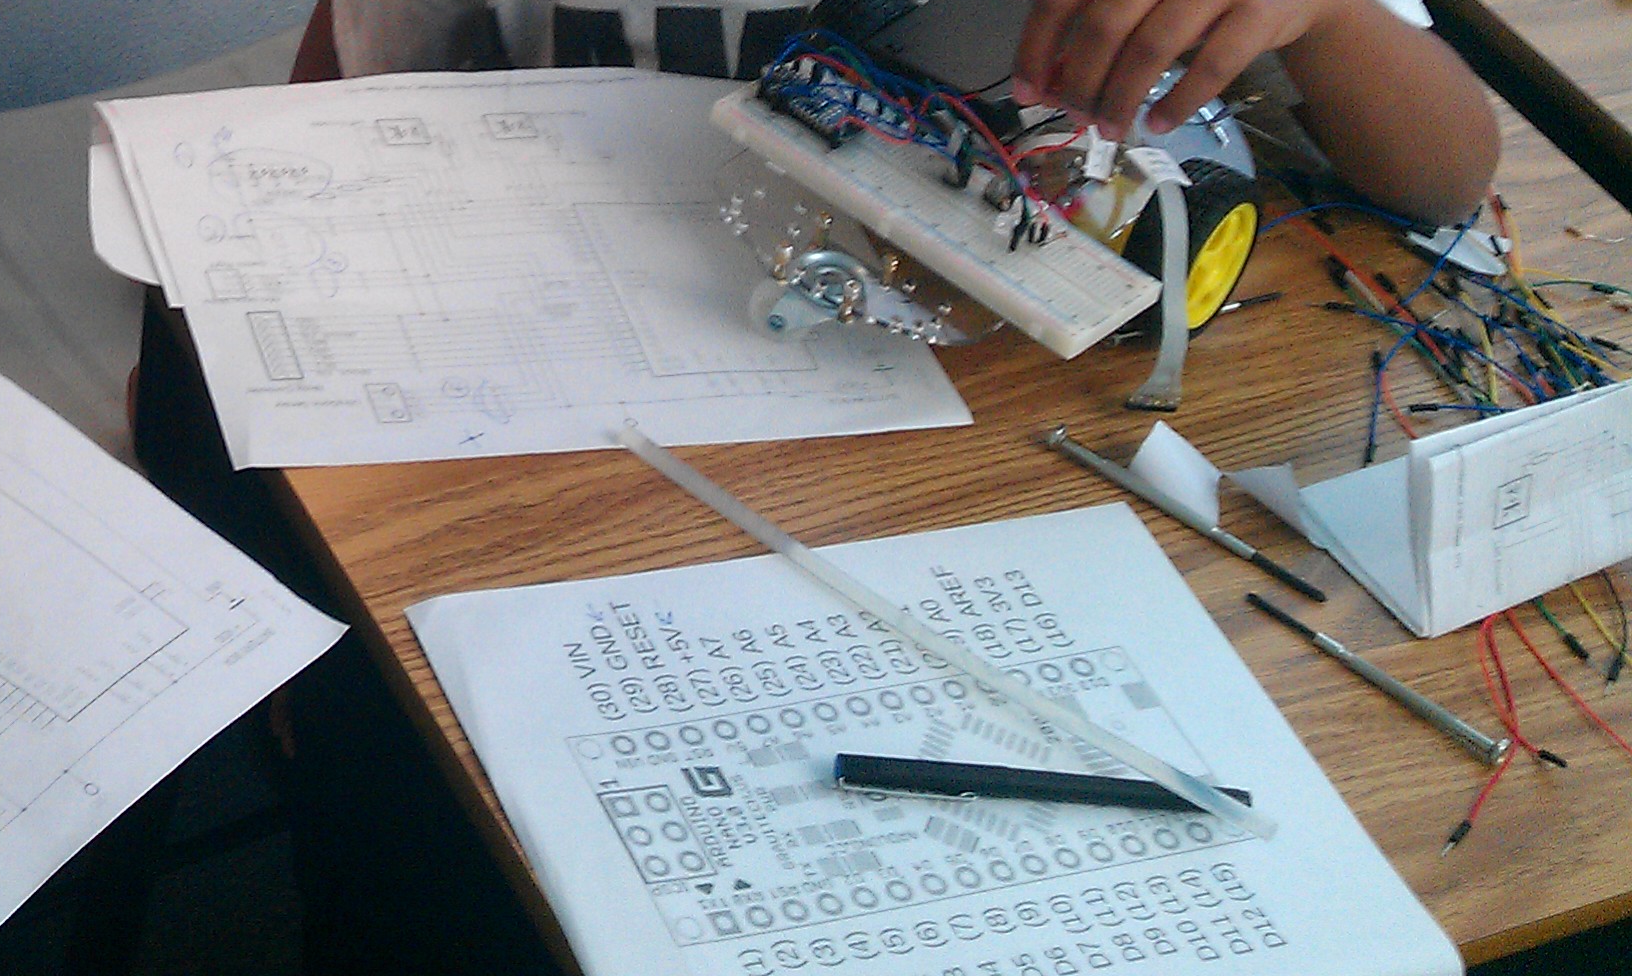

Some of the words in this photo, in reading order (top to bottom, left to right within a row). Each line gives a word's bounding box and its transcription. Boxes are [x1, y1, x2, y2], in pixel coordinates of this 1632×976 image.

[929, 565, 982, 617] AREF
[972, 575, 1012, 613] 3V3
[1002, 569, 1043, 607] D13
[825, 613, 858, 638] A3
[918, 598, 952, 623] A0
[588, 624, 629, 671] GND
[607, 601, 665, 670] RESET
[657, 626, 694, 663] +5V
[697, 636, 731, 660] A7
[730, 628, 764, 653] A6
[763, 623, 796, 648] A5
[794, 619, 828, 643] A4
[970, 622, 1013, 659] (18)
[1001, 617, 1045, 654] (17)
[1032, 611, 1076, 648] (16)
[562, 642, 597, 680] VIN
[782, 654, 825, 691] (24)
[814, 649, 857, 685] (23)
[845, 643, 888, 680] (22)
[877, 636, 920, 675] (21)
[617, 676, 659, 714] (29)
[651, 673, 695, 713] (28)
[684, 667, 728, 707] (27)
[717, 665, 760, 703] (26)
[750, 660, 793, 697] (25)
[585, 682, 627, 721] (30)
[1143, 874, 1190, 915] (13)
[1175, 868, 1223, 908] (14)
[1208, 861, 1256, 901] (15)
[1012, 899, 1051, 927] (9)
[1044, 893, 1094, 934] (10)
[1079, 886, 1126, 927] (11)
[1110, 880, 1156, 921] (12)
[911, 919, 949, 948] (6)
[946, 912, 985, 941] (7)
[980, 906, 1018, 934] (8)
[1209, 913, 1254, 955] D11
[1240, 906, 1288, 948] D12
[769, 938, 809, 969] (2)
[807, 936, 847, 967] (3)
[841, 930, 881, 960] (4)
[876, 926, 915, 955] (5)
[1074, 942, 1114, 969] D7
[1110, 932, 1146, 962] D8
[1142, 926, 1178, 956] D9
[1175, 919, 1221, 962] D10
[1042, 946, 1080, 976] D6
